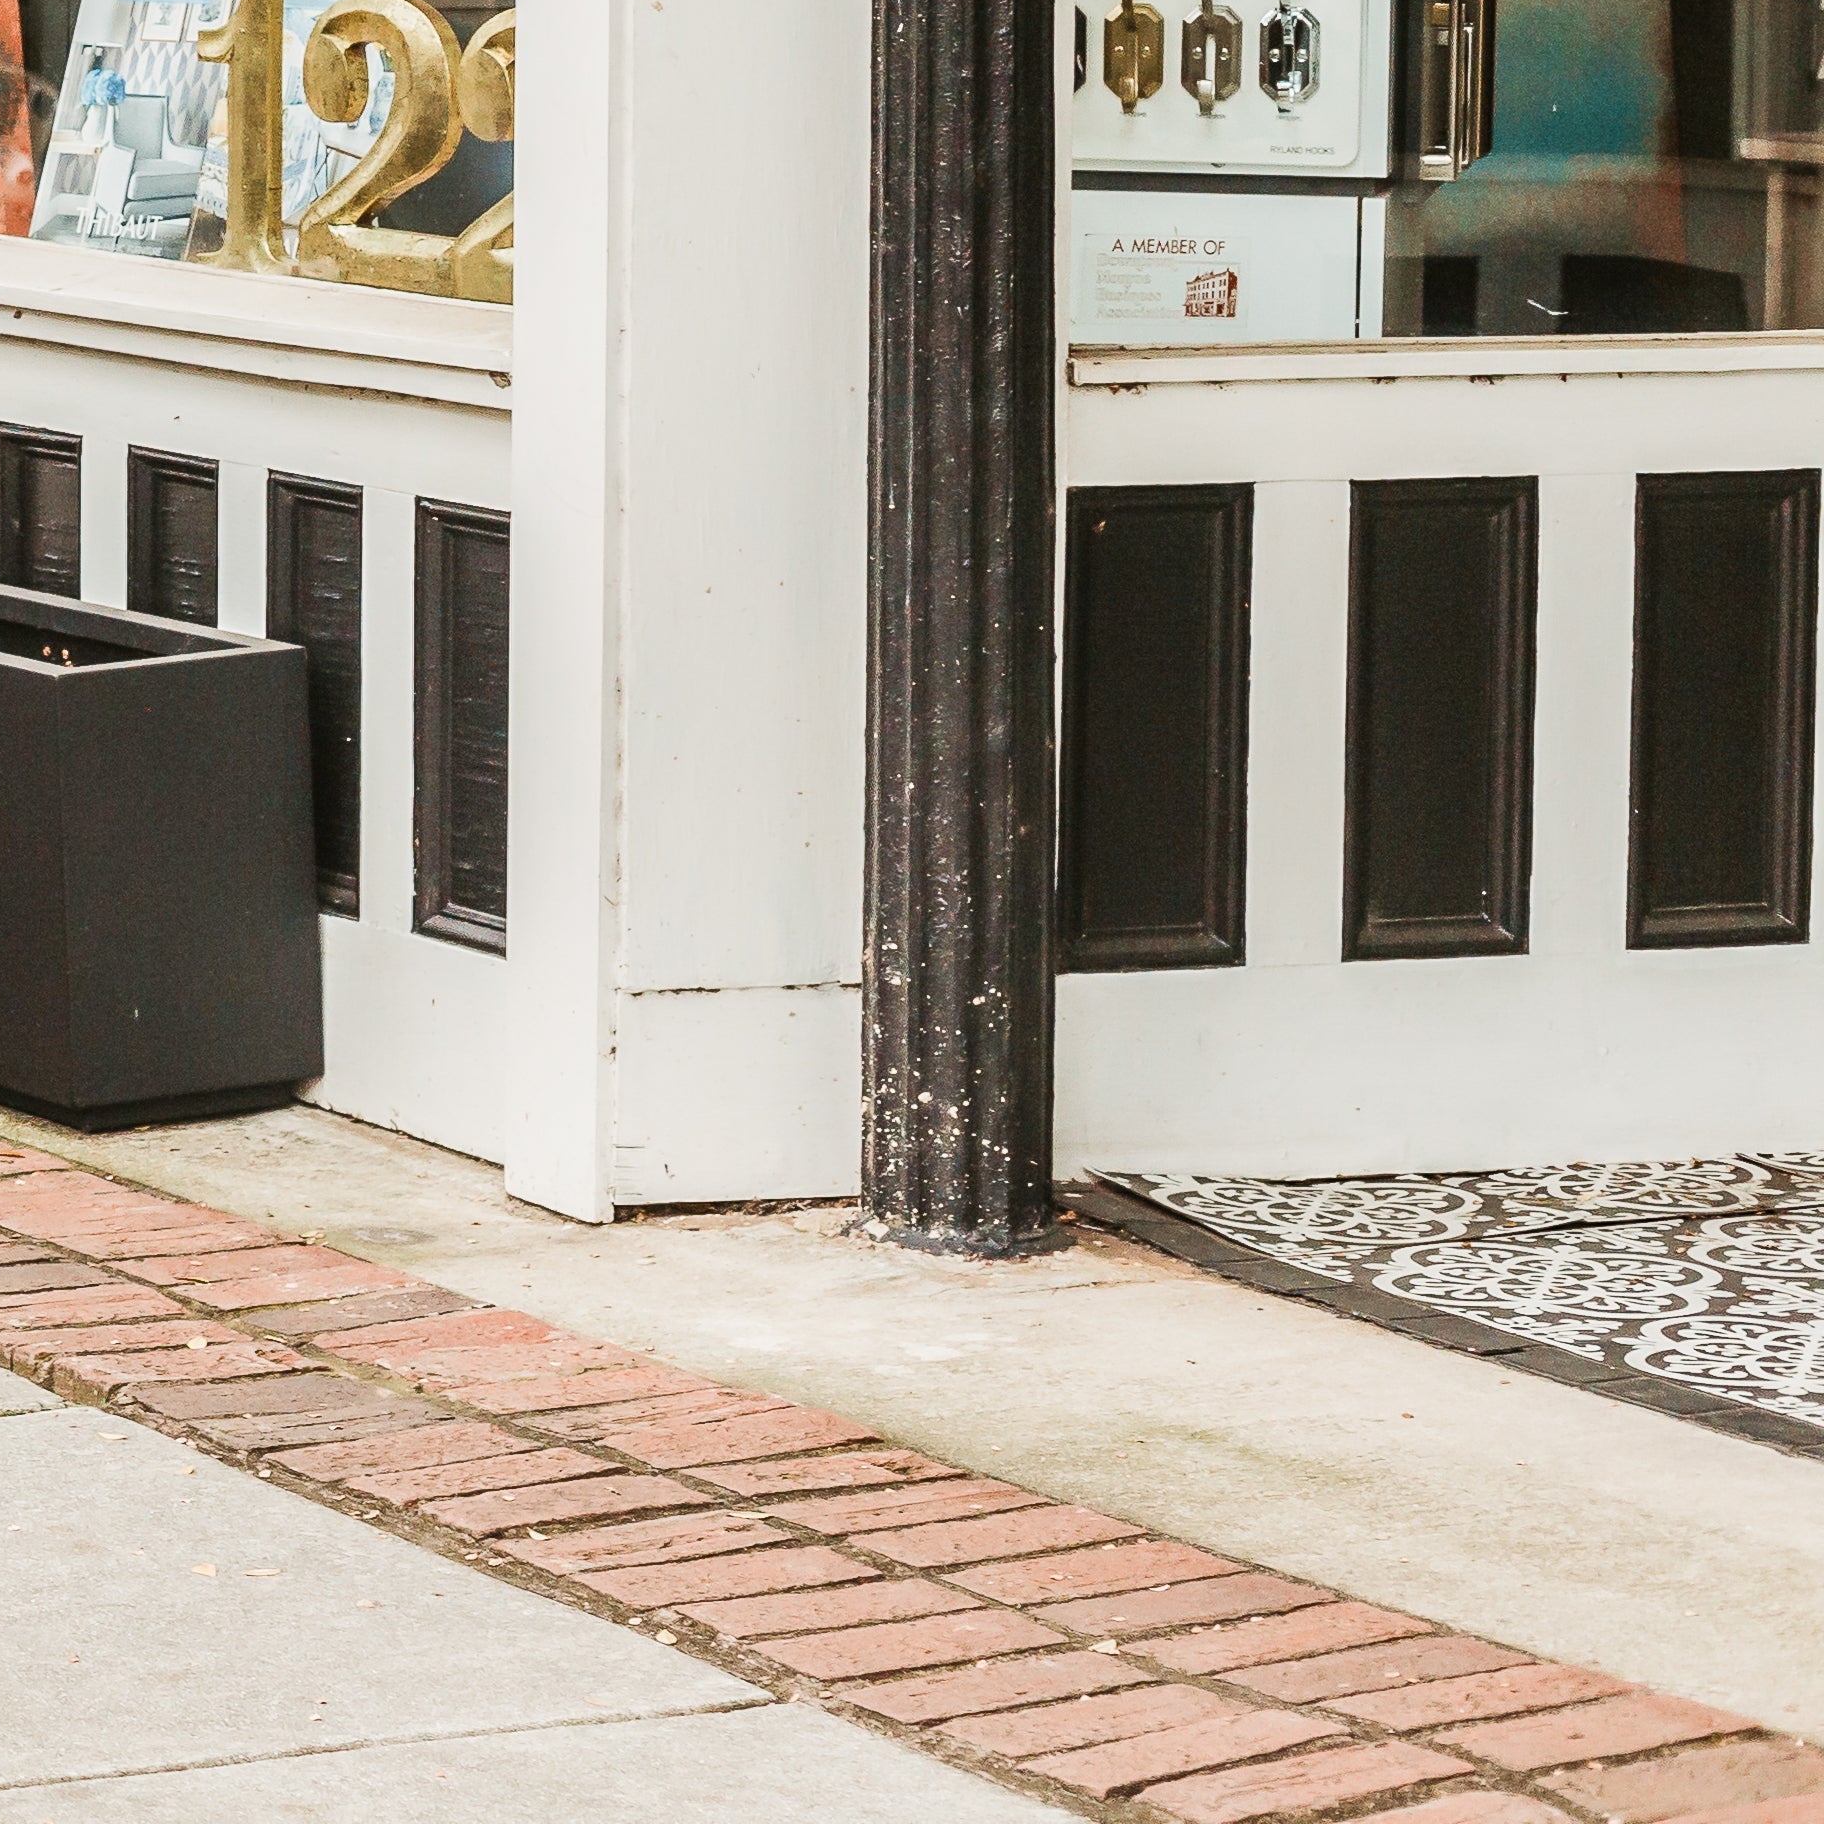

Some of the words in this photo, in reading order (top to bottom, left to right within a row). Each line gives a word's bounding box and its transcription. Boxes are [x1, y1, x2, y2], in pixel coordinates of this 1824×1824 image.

[75, 206, 164, 241] THIBAUT
[1111, 238, 1124, 253] A
[1131, 238, 1197, 255] MEMBER
[1203, 239, 1226, 256] OF
